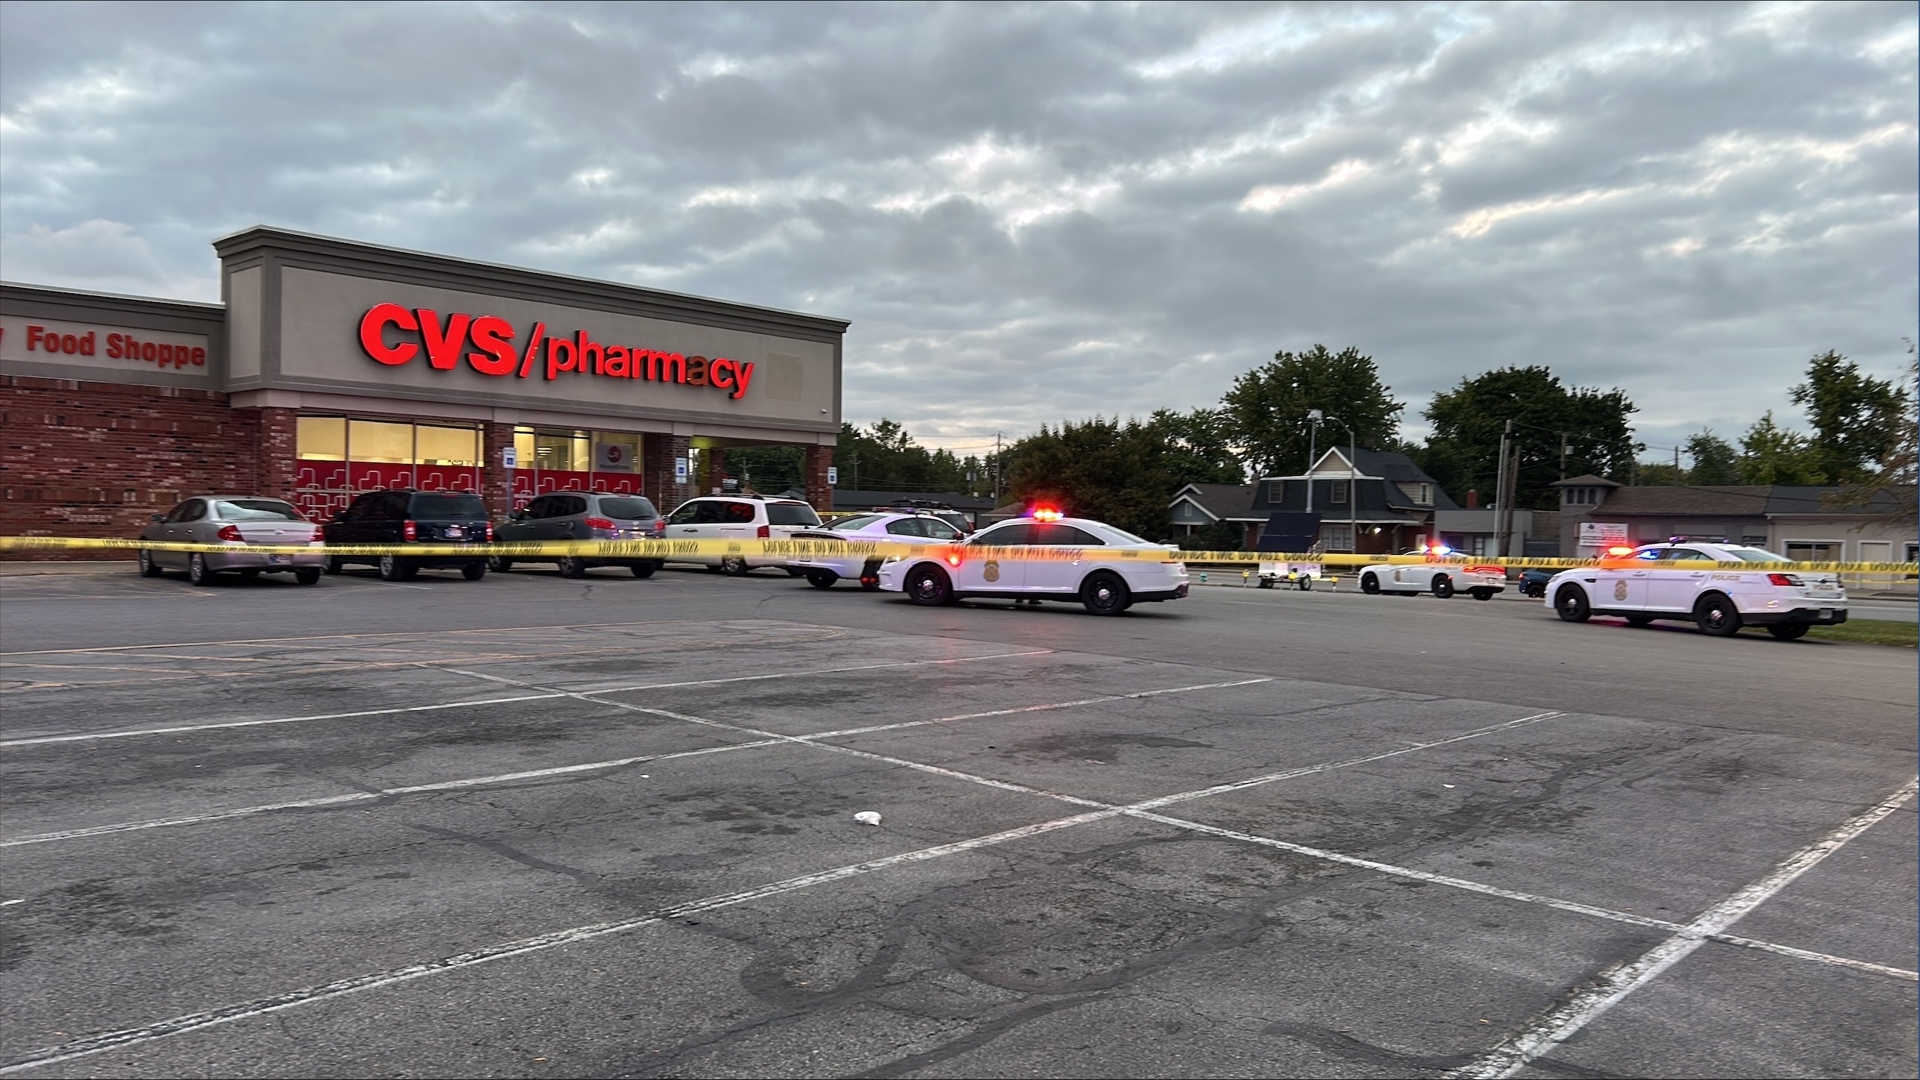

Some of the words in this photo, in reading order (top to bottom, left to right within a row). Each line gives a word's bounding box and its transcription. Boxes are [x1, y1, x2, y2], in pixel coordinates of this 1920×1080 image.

[27, 325, 95, 357] Food
[106, 332, 207, 369] Shoppe
[358, 302, 755, 400] CVS/pharmacy
